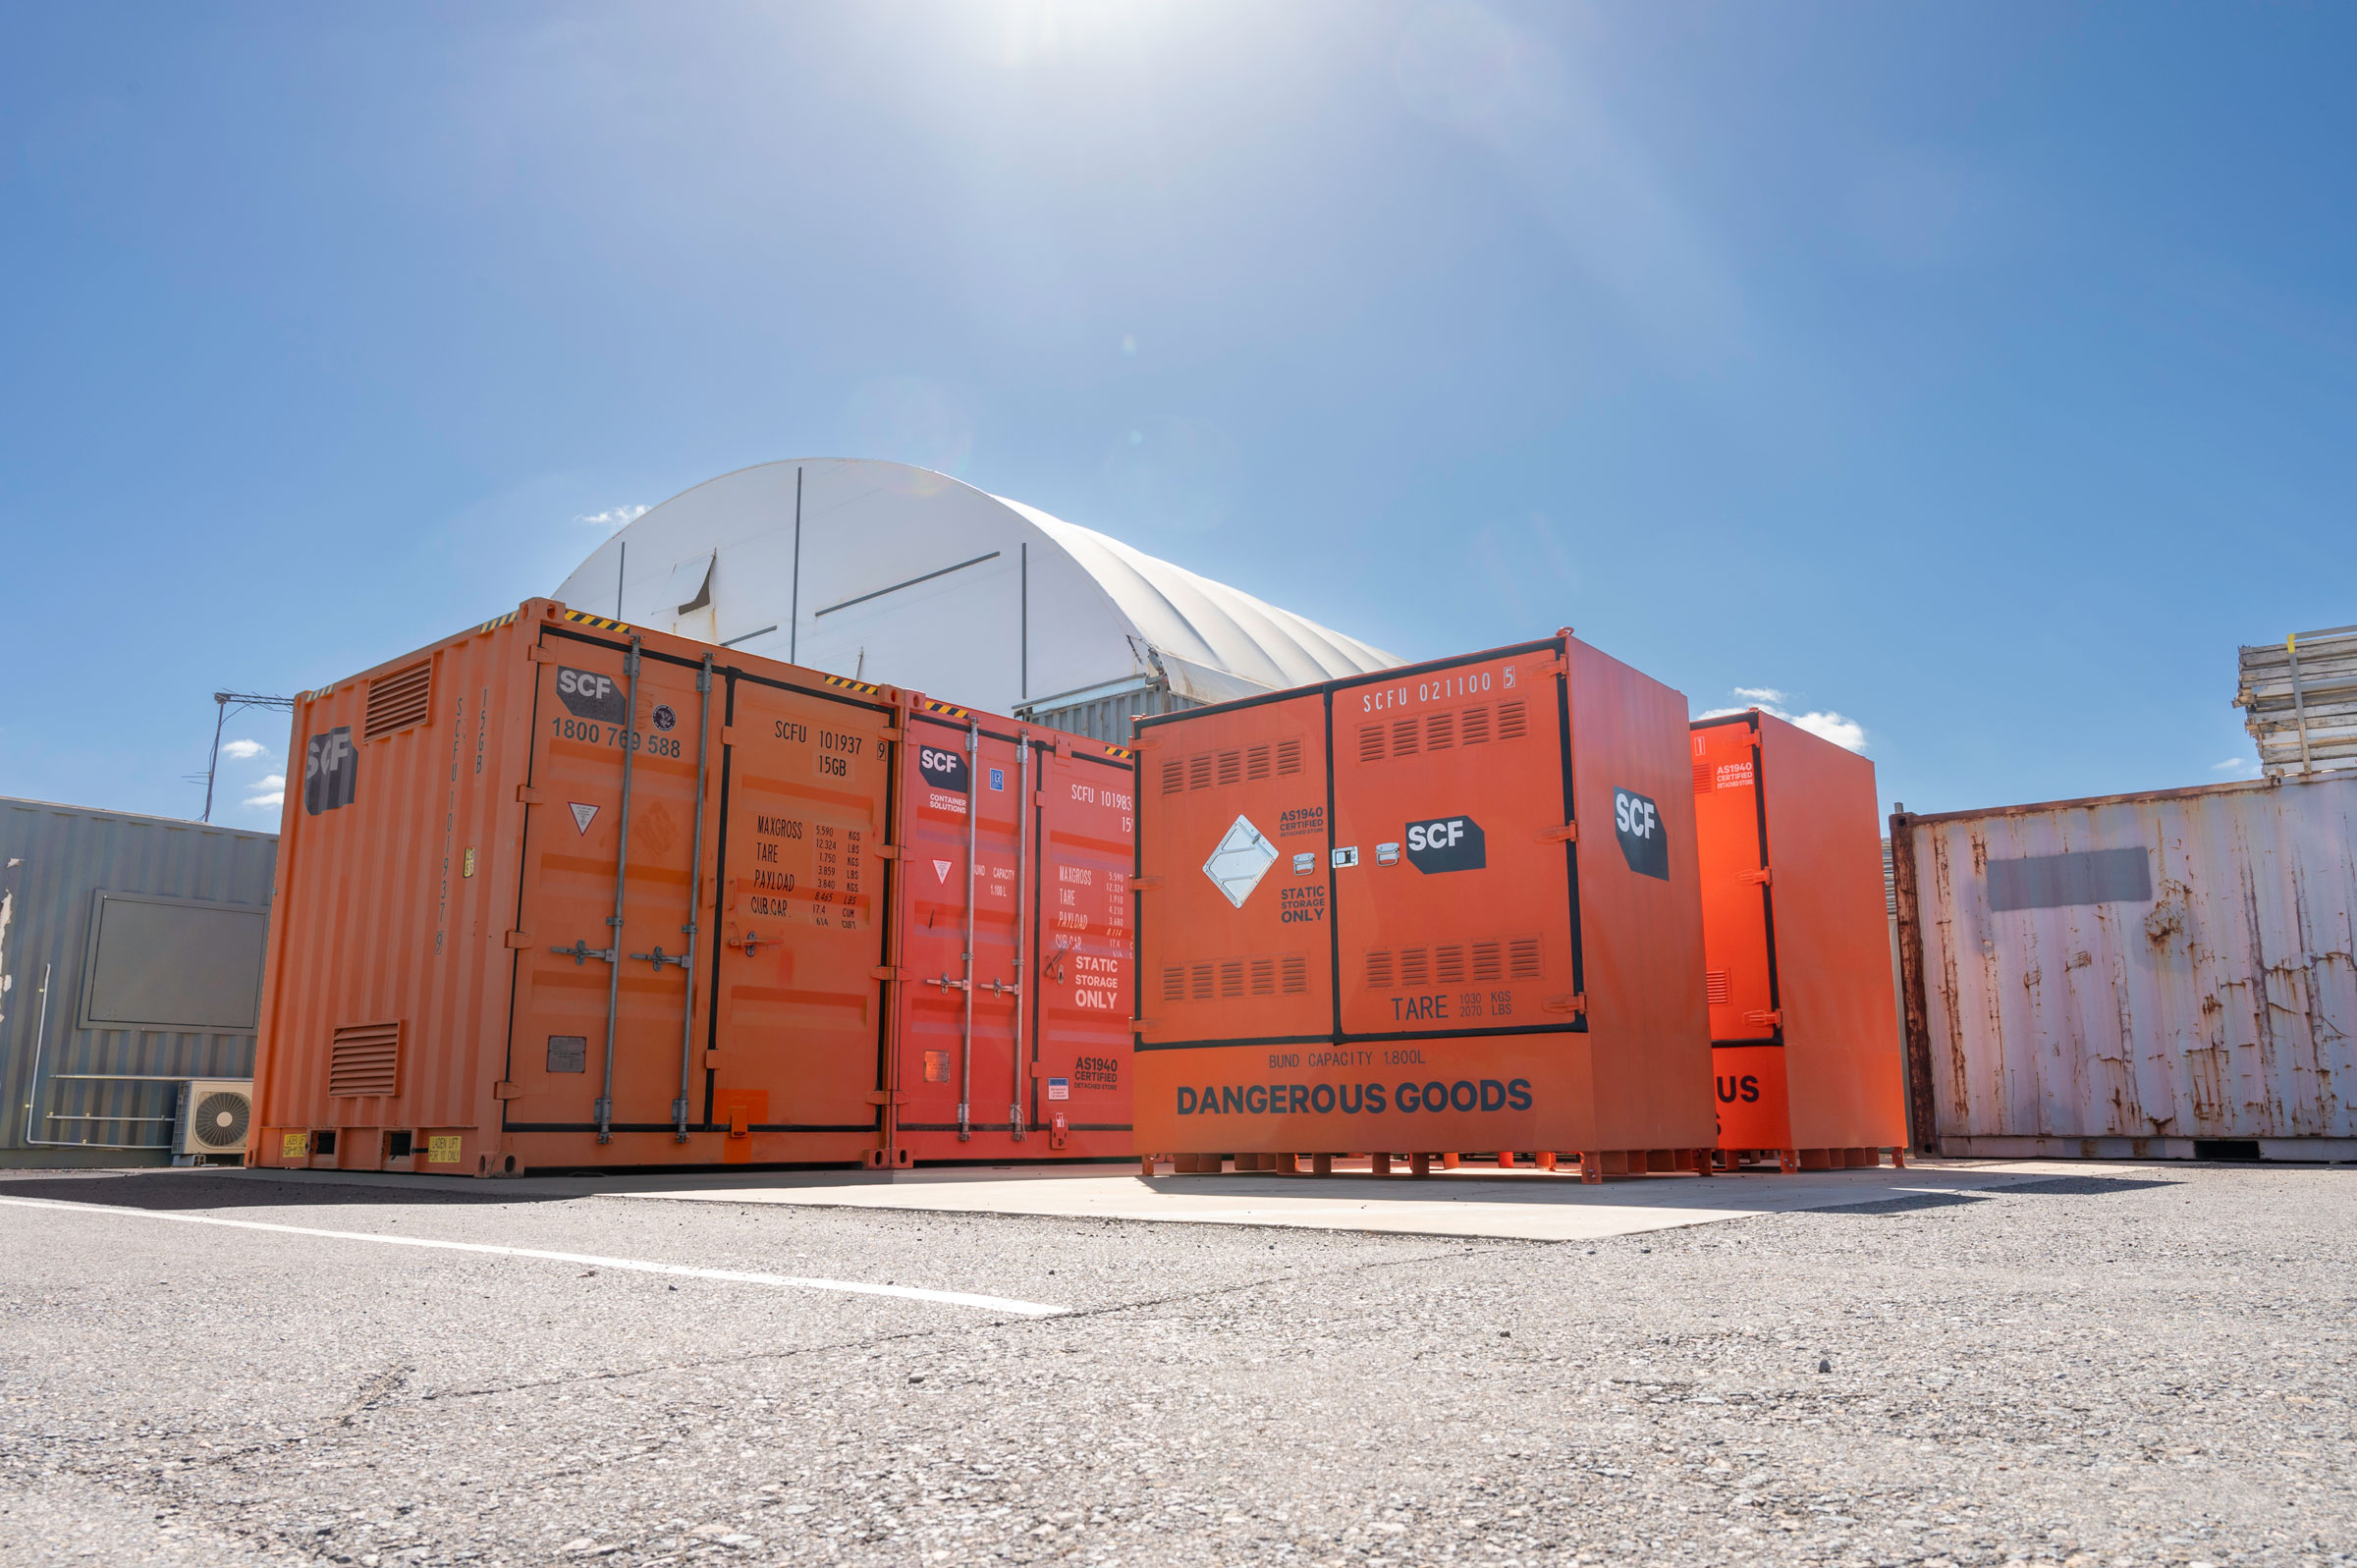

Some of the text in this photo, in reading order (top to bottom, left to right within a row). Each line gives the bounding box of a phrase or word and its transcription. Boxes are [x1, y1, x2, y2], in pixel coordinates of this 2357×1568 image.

[559, 670, 611, 699] SCF
[1363, 687, 1407, 713] SCFU
[1419, 672, 1491, 702] 021100
[451, 697, 463, 782] SCFU
[552, 717, 681, 759] 1800 769 588
[775, 720, 806, 743] SCFU
[819, 730, 862, 755] 101937
[819, 755, 847, 777] 15GB
[921, 749, 957, 774] SCF
[1717, 762, 1753, 775] AS1940
[1717, 771, 1753, 783] CERTIFIED
[929, 793, 966, 807] CONTAINER
[1071, 784, 1132, 811] SCFU 101983
[929, 800, 966, 815] SOLUTIONS
[1280, 806, 1323, 822] AS1940
[1616, 793, 1656, 839] SCF
[757, 815, 802, 839] MAXGROSS
[849, 831, 860, 841] KGS
[1122, 816, 1133, 833] 15
[1280, 819, 1324, 832] CERTIFIED
[1408, 820, 1464, 851] SCF
[756, 841, 779, 863] TARE
[847, 857, 858, 867] KGS
[848, 843, 860, 854] LBS
[753, 869, 795, 892] PAYLOAD
[847, 883, 858, 892] KGS
[847, 870, 858, 880] LBS
[973, 864, 1015, 881] UND CAPACITY
[1059, 865, 1092, 886] MAXGROSS
[844, 895, 856, 905] LBS
[1059, 888, 1075, 906] TARE
[1281, 886, 1325, 900] STATIC
[842, 907, 854, 918] CUM
[1281, 898, 1325, 910] STORAGE
[1057, 911, 1088, 930] PAYLOAD
[1281, 907, 1325, 923] ONLY
[1075, 955, 1119, 973] STATIC
[1075, 974, 1119, 989] STORAGE
[1074, 989, 1118, 1009] ONLY
[1391, 995, 1449, 1021] TARE
[1491, 991, 1511, 1002] KGS
[1492, 1003, 1512, 1016] LBS
[1075, 1056, 1118, 1072] AS1940
[1269, 1054, 1299, 1069] BUND
[1308, 1051, 1373, 1067] CAPACITY
[1074, 1070, 1118, 1083] CERTIFIED
[1177, 1077, 1533, 1115] DANGEROUS GOODS
[1717, 1074, 1760, 1104] US
